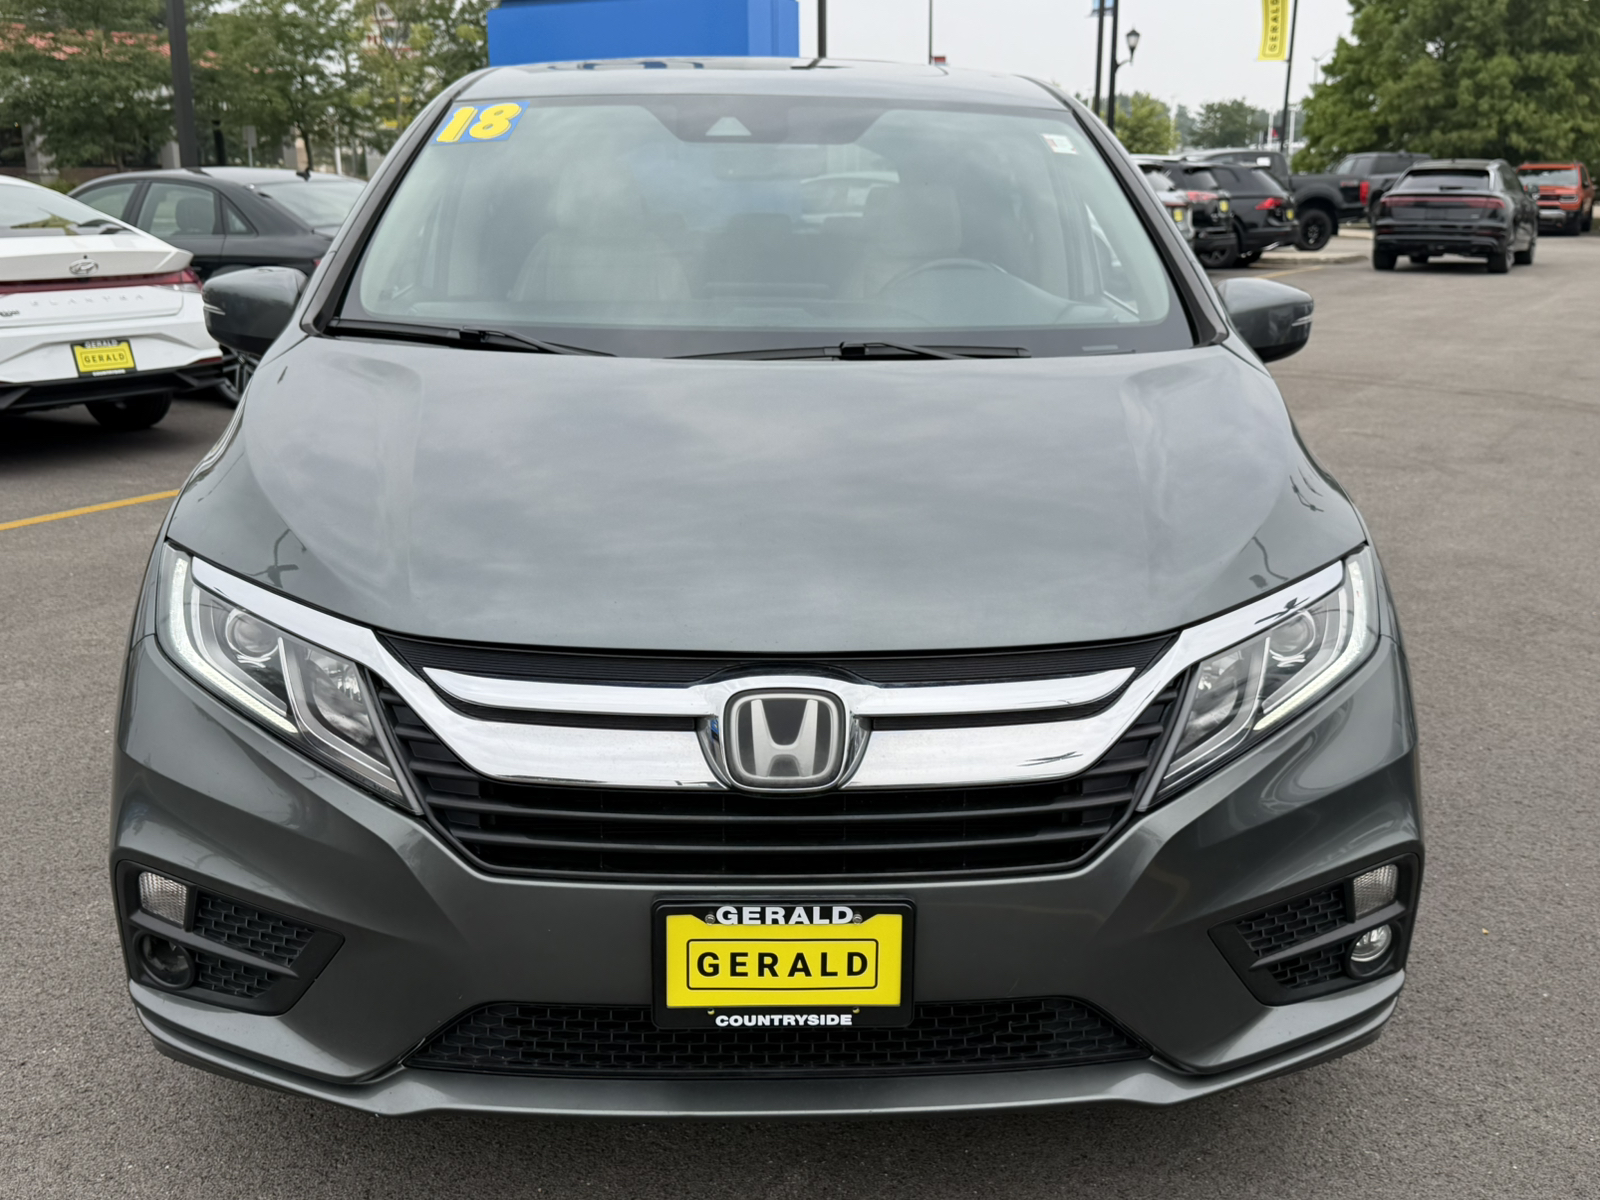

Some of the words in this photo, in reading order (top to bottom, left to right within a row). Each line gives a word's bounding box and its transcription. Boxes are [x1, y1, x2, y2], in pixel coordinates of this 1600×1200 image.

[436, 102, 522, 142] 18
[83, 352, 126, 364] GERALD
[715, 906, 855, 926] GERALD
[696, 951, 869, 978] GERALD
[715, 1013, 853, 1027] COUNTRYSIDE
